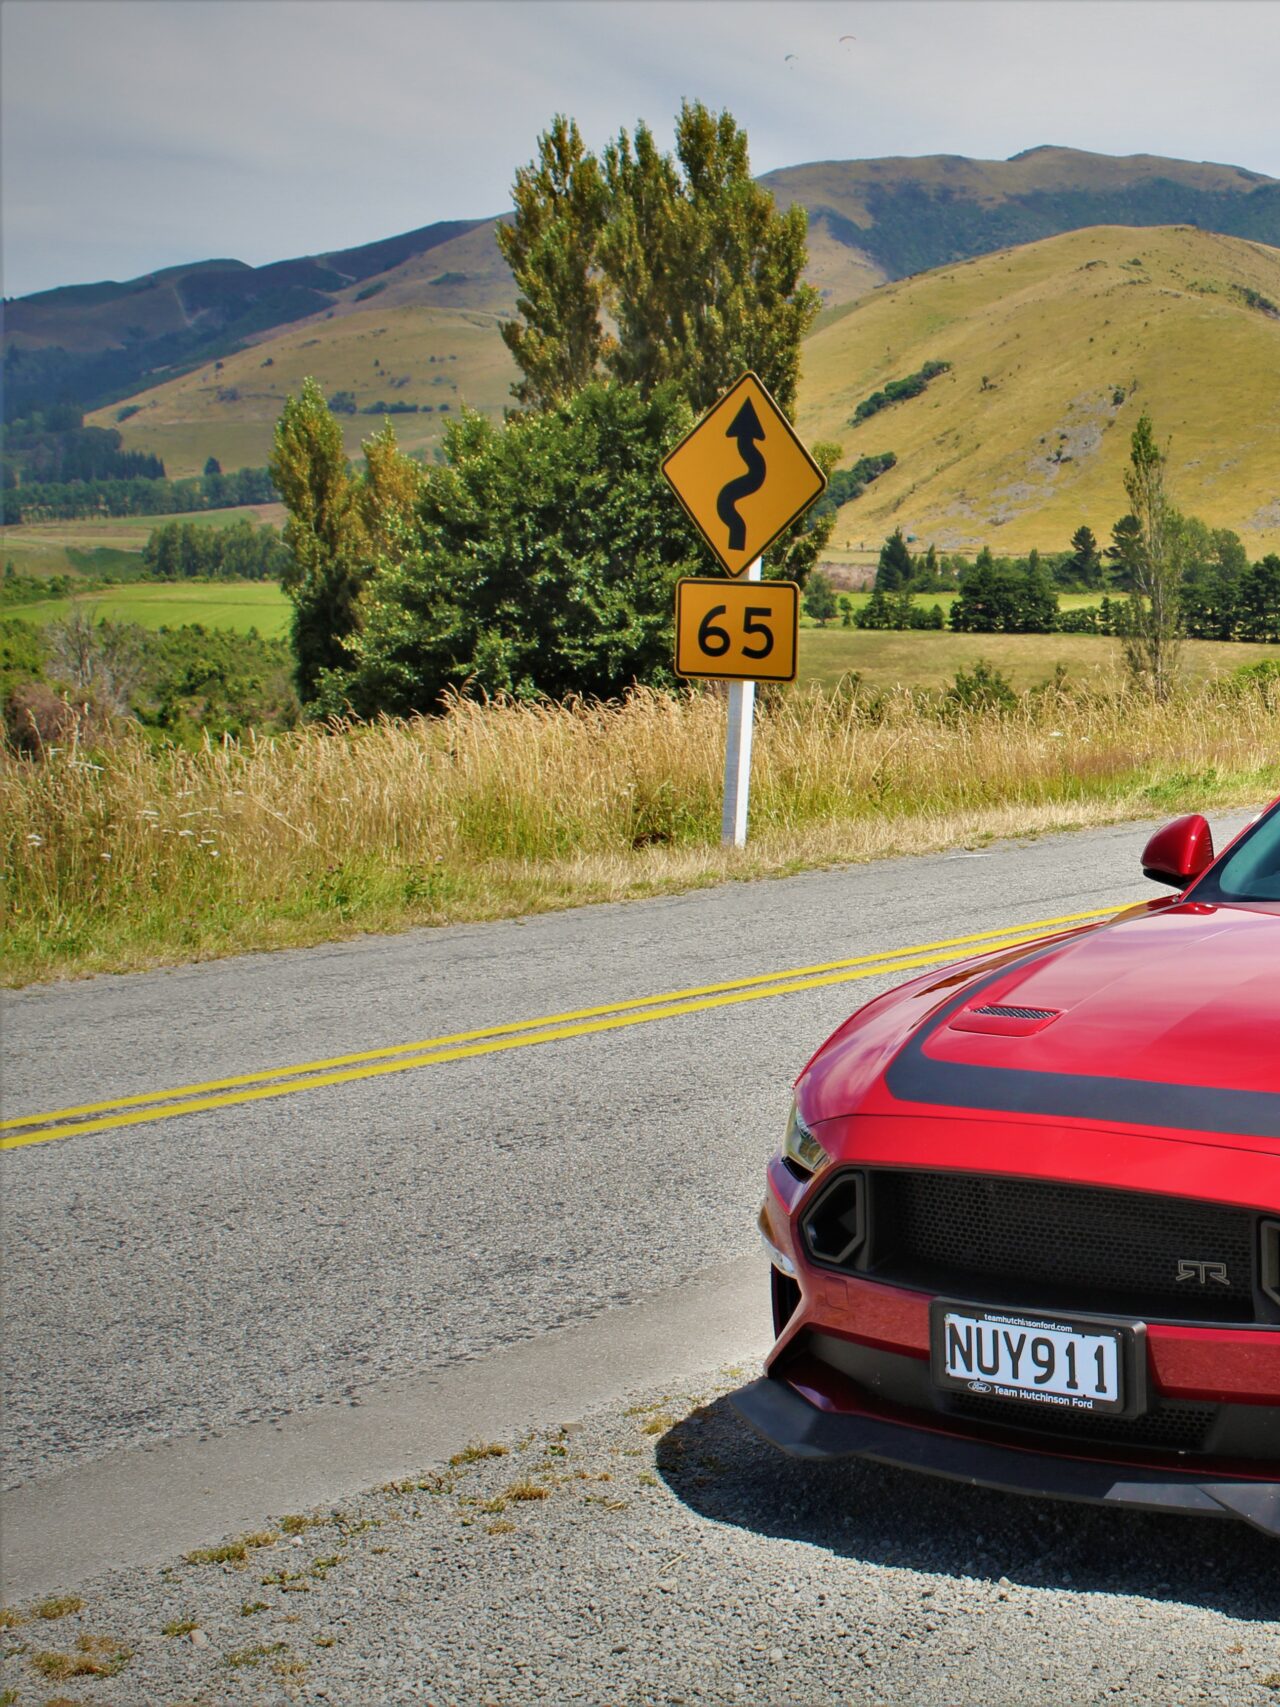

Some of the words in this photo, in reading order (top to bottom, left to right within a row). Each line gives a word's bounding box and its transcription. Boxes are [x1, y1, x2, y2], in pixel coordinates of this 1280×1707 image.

[698, 605, 774, 659] 65
[984, 1313, 1072, 1333] teamhutchinsonford.com
[950, 1323, 1107, 1394] NUY911
[994, 1385, 1018, 1398] Team
[1019, 1389, 1070, 1406] Hutchinson
[1072, 1398, 1093, 1409] Ford
